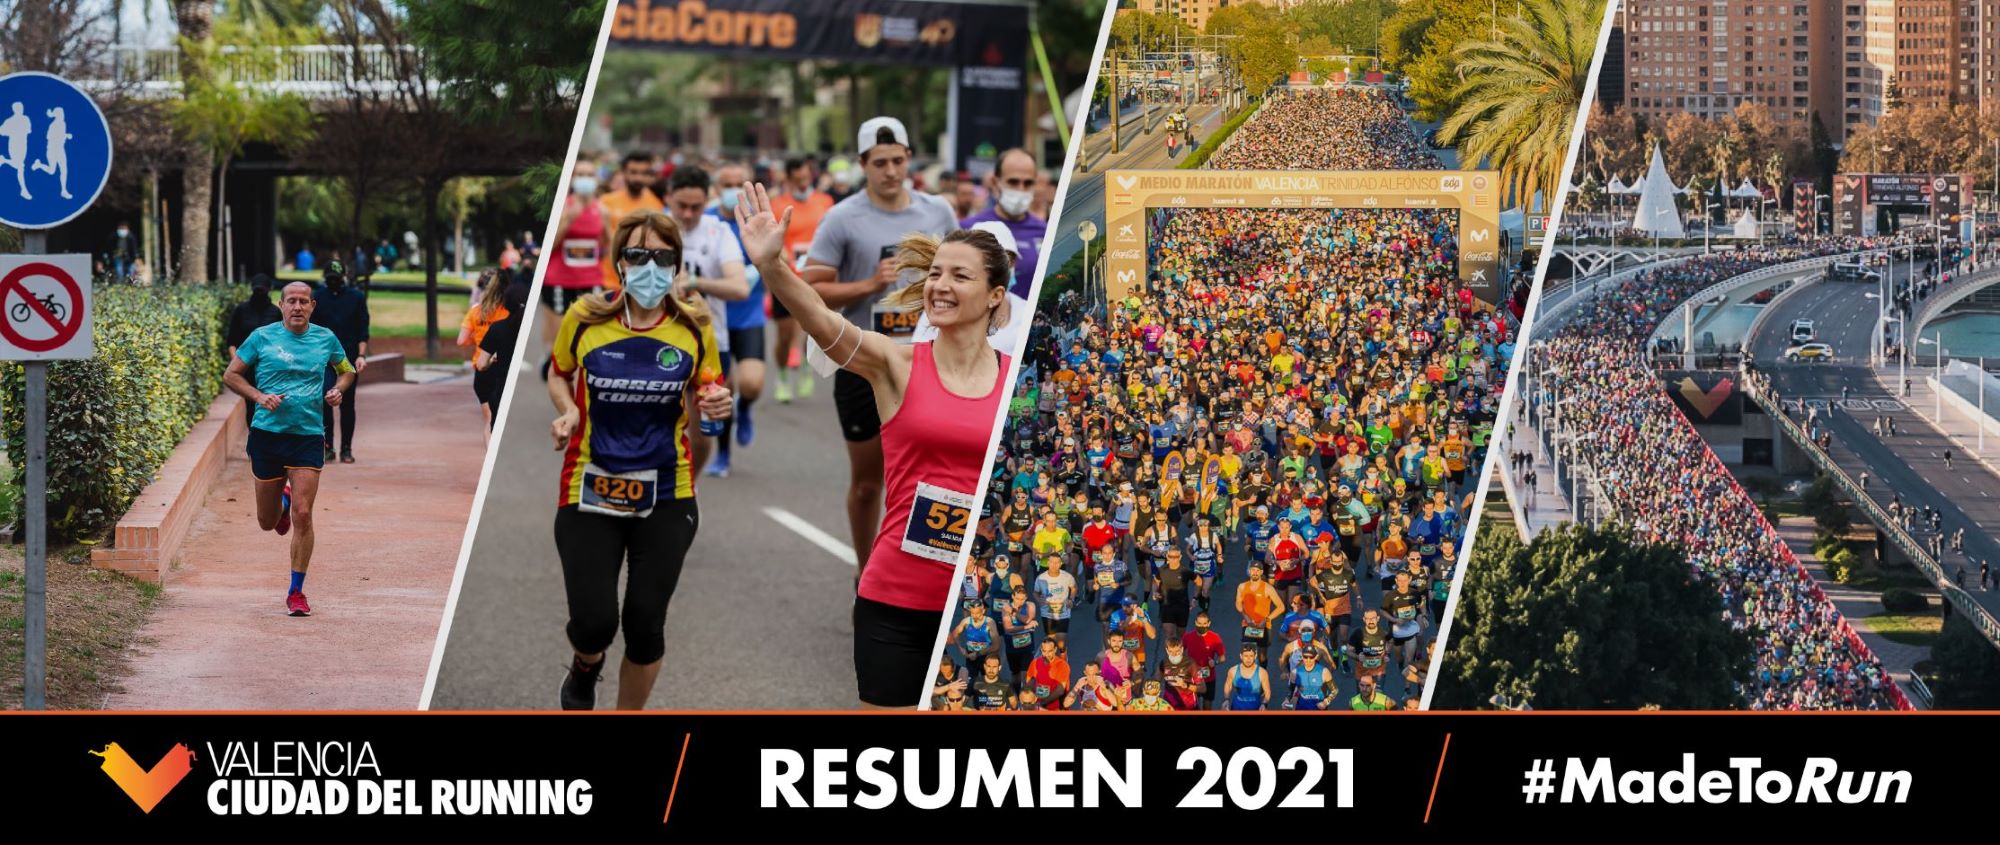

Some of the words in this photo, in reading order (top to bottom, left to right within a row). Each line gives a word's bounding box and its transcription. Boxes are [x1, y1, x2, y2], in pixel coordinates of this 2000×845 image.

[1139, 176, 1182, 190] MEDIO
[1185, 173, 1253, 190] MARATÓN
[1255, 176, 1320, 191] VALENCIA
[1320, 176, 1378, 191] TRINIDAD
[1379, 176, 1439, 191] ALFONSO
[1532, 218, 1539, 229] P
[587, 373, 686, 391] TORRENT
[598, 391, 677, 404] CORRE
[593, 476, 644, 500] 820
[925, 502, 971, 535] 52
